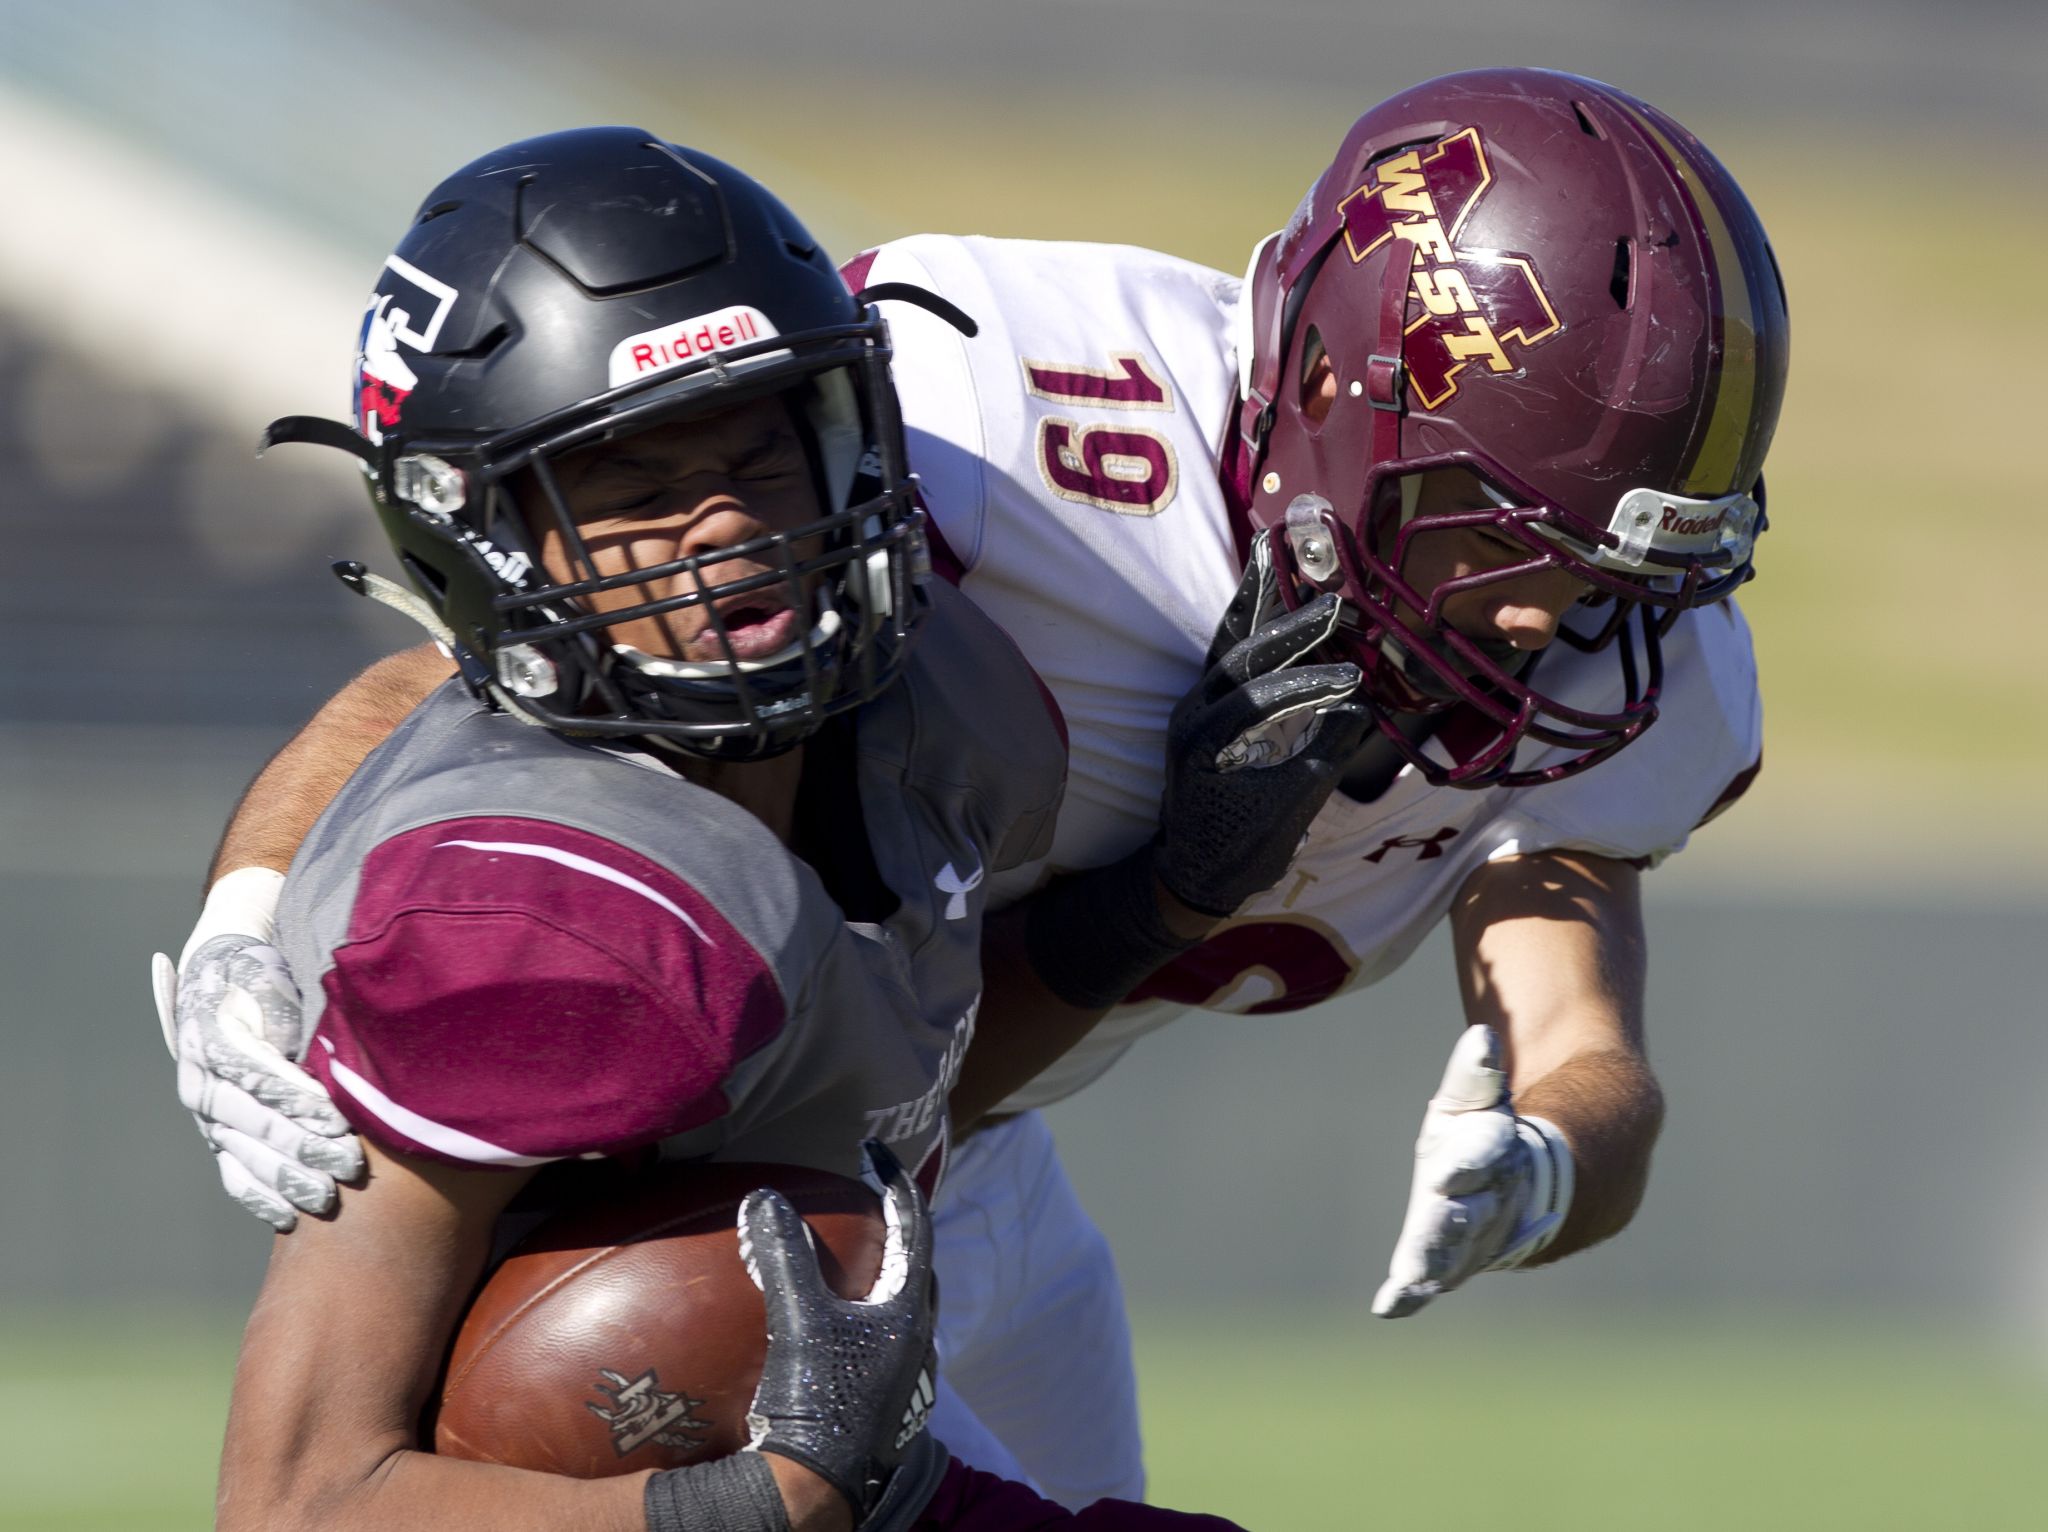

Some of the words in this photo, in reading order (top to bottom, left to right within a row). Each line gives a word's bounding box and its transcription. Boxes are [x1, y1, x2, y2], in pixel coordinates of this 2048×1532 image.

[1376, 150, 1514, 372] WEST
[631, 312, 758, 372] Riddell
[1020, 350, 1179, 517] 19
[858, 1078, 939, 1146] THE
